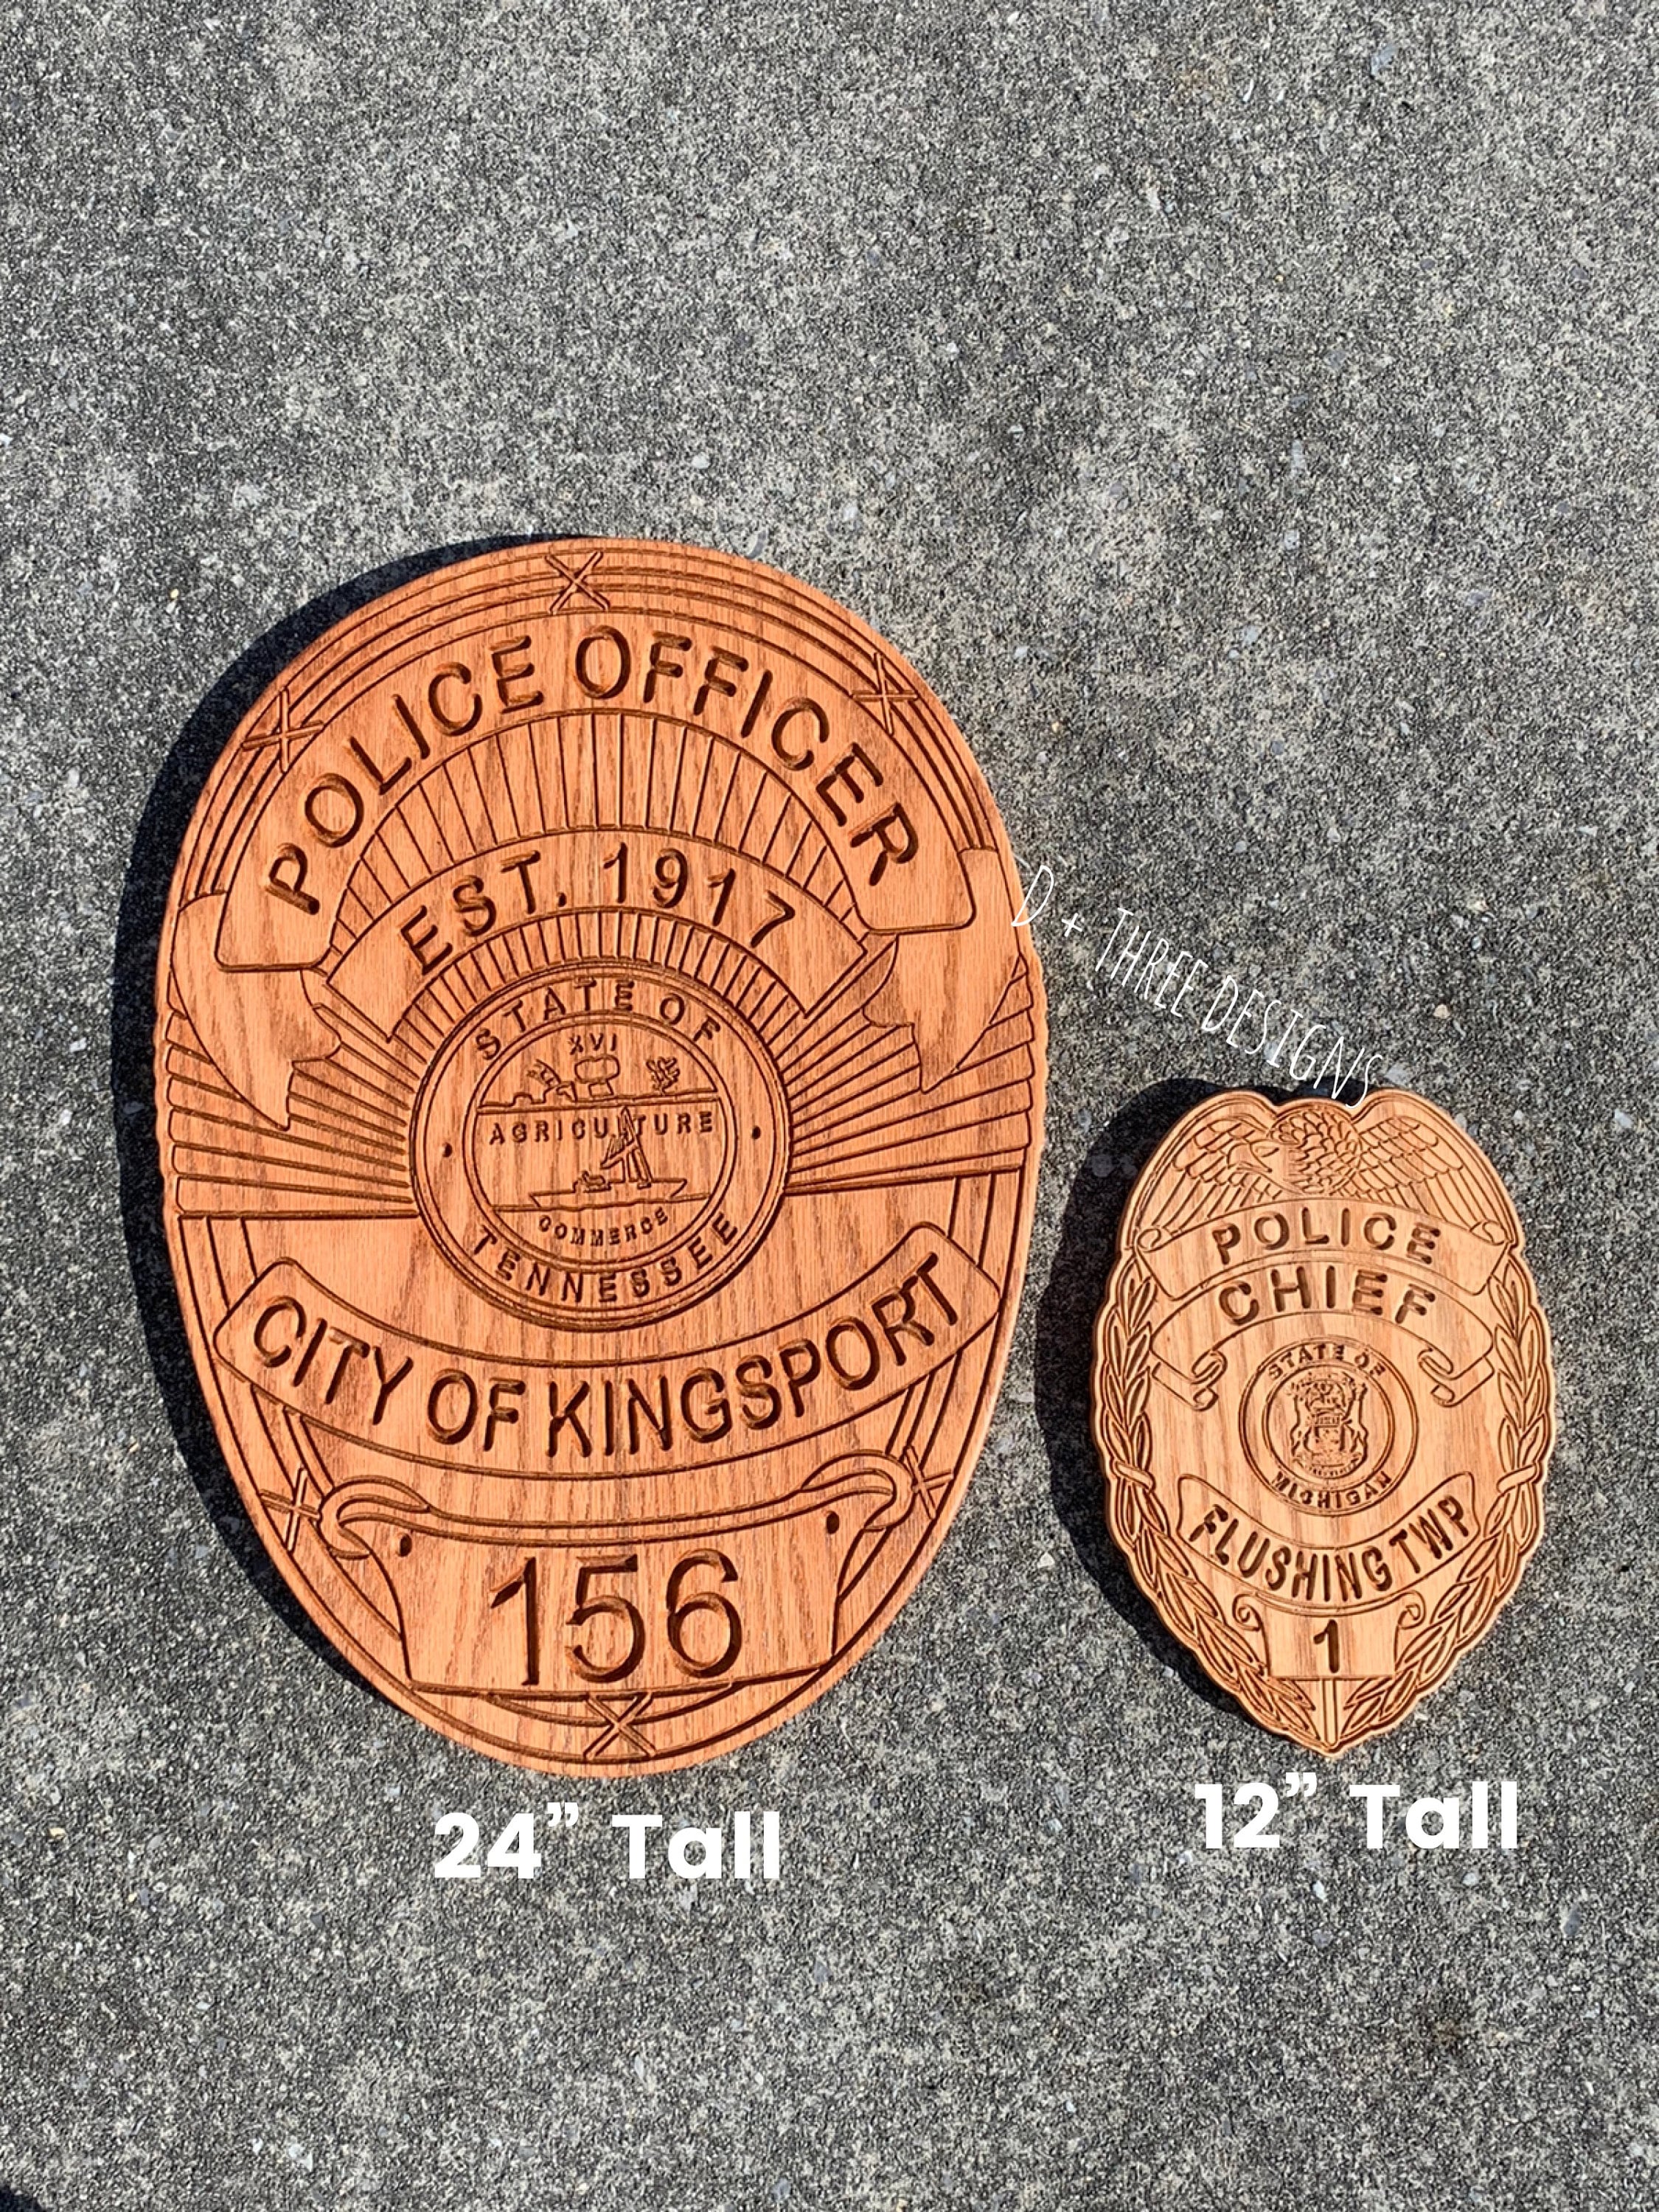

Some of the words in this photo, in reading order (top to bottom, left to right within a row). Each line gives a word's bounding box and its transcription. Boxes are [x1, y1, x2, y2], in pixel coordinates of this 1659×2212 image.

[266, 635, 543, 914] POLICE
[575, 625, 919, 884] OFFICER
[400, 852, 566, 974] EST.
[604, 843, 795, 948] 1917
[476, 977, 634, 1060] STATE
[660, 994, 720, 1045] OF
[569, 1033, 617, 1054] XVI
[470, 1211, 738, 1302] TENNESSEE
[539, 1208, 668, 1246] COMMERCE
[1213, 1208, 1440, 1265] POLICE
[1219, 1266, 1436, 1325] CHIEF
[253, 1295, 413, 1425] CITY
[428, 1368, 526, 1452] OF
[547, 1253, 960, 1457] KINGSPORT
[1268, 1343, 1344, 1380] STATE
[1354, 1352, 1385, 1377] OF
[1272, 1471, 1391, 1508] MICHIGAN
[1189, 1503, 1392, 1602] FLUSHING
[1390, 1495, 1468, 1573] TWP
[490, 1549, 742, 1686] 156
[1313, 1619, 1340, 1674] 1
